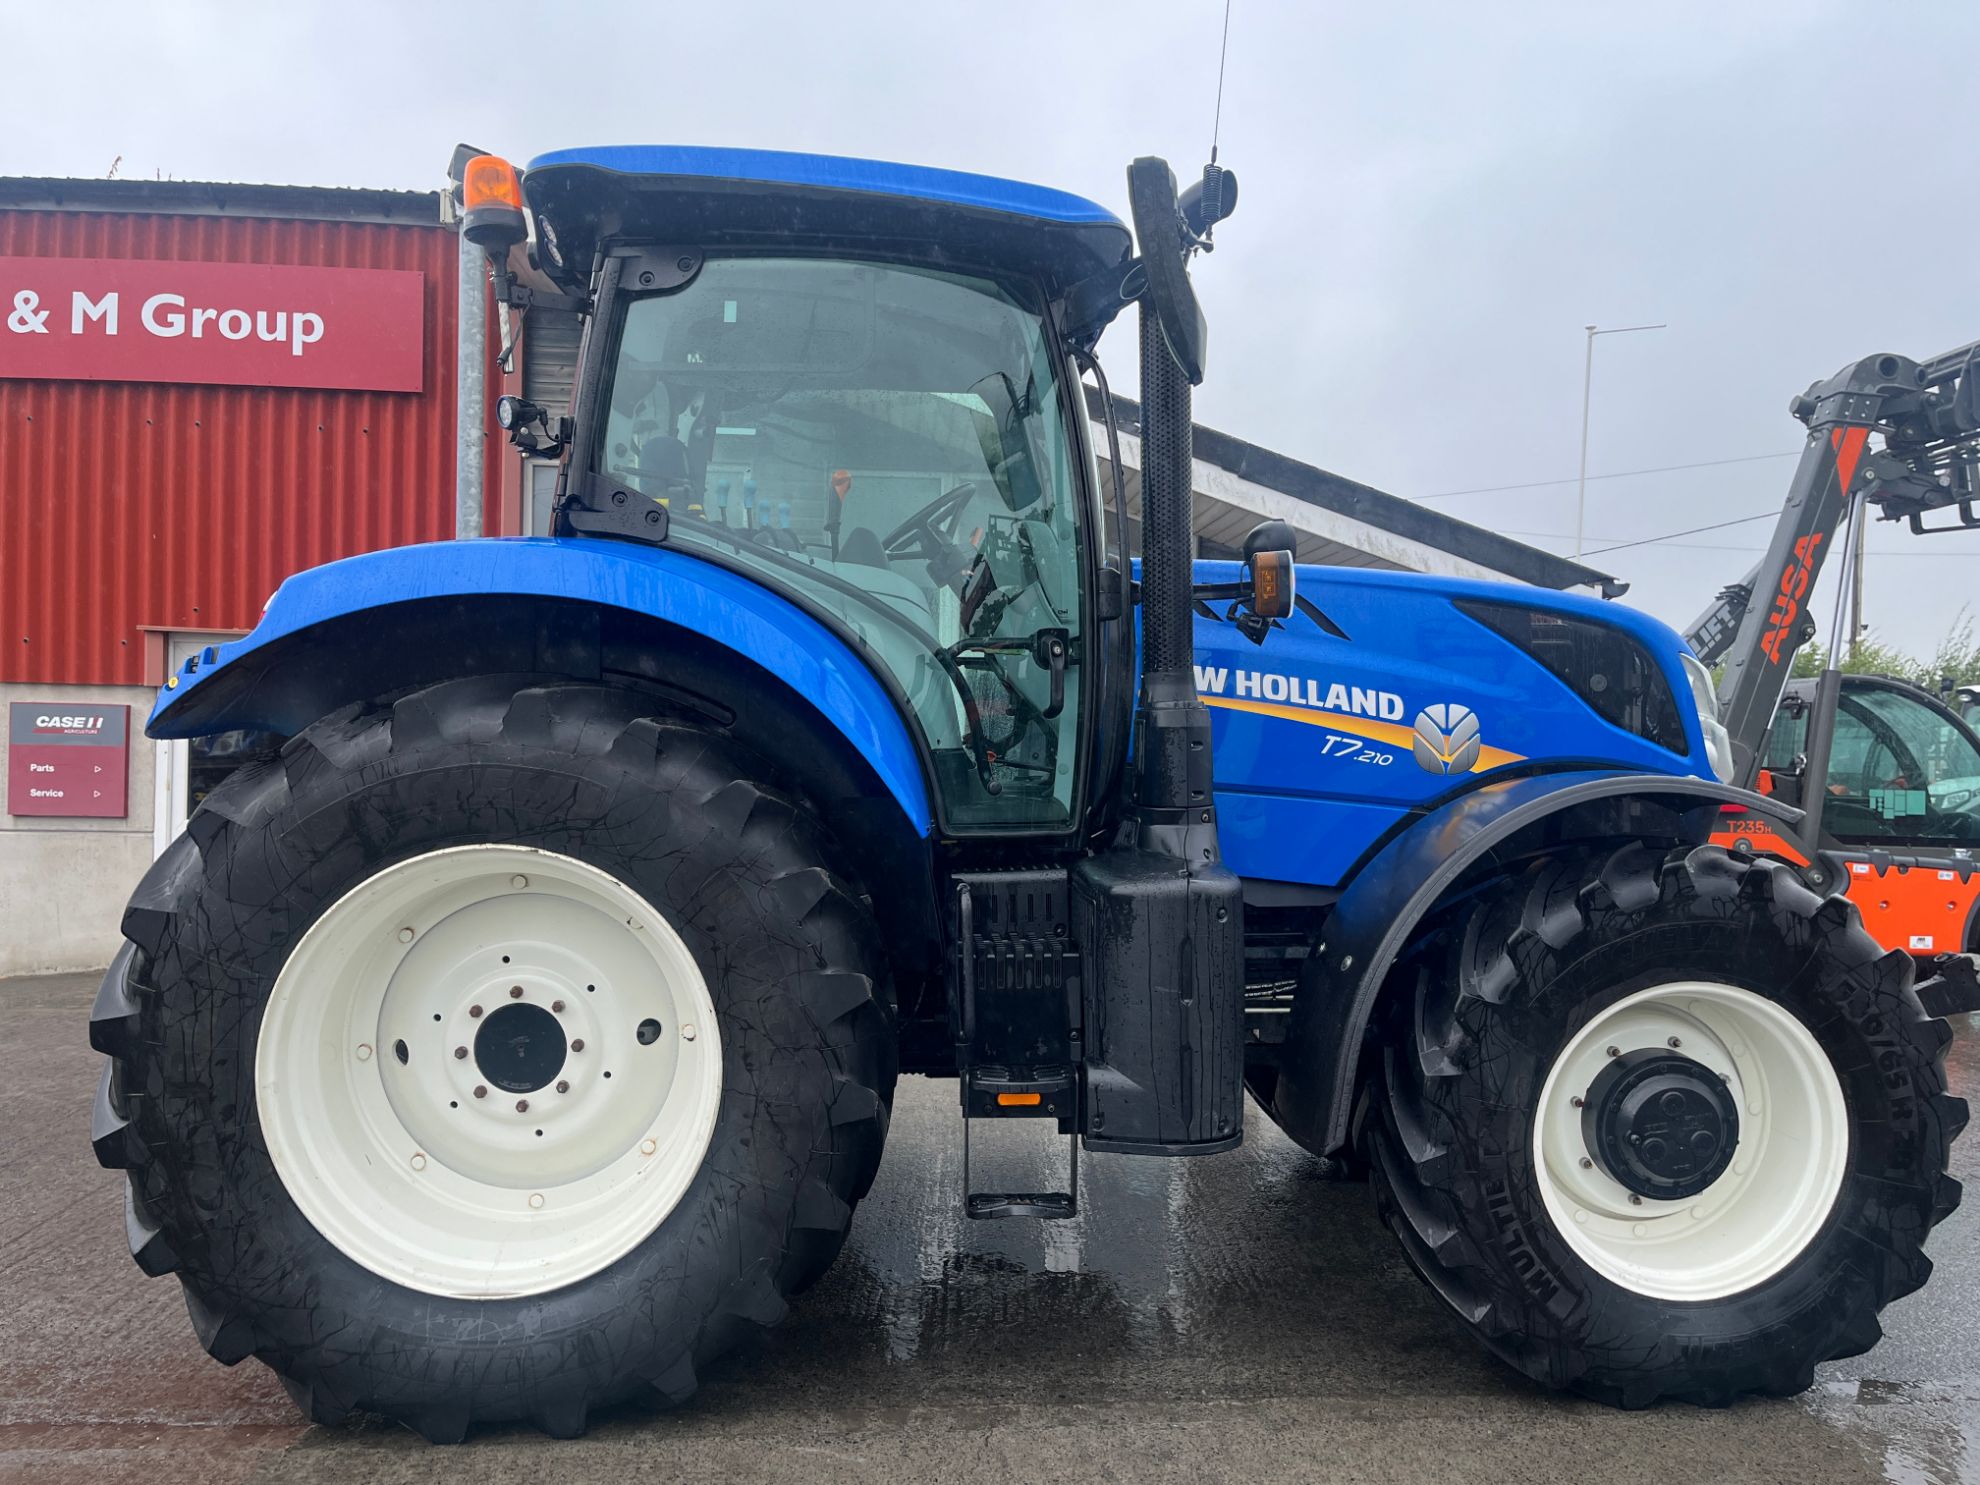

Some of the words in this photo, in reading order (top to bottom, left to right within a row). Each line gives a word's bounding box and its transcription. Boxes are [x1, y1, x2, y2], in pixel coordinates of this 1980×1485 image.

[7, 290, 50, 334] &
[71, 291, 119, 335] M
[141, 293, 325, 356] Group
[1760, 532, 1824, 666] AUSA
[1235, 669, 1405, 722] HOLLAND
[36, 715, 86, 728] CASE
[1321, 734, 1394, 766] T7.210
[30, 763, 55, 773] Parts
[30, 788, 64, 798] Service
